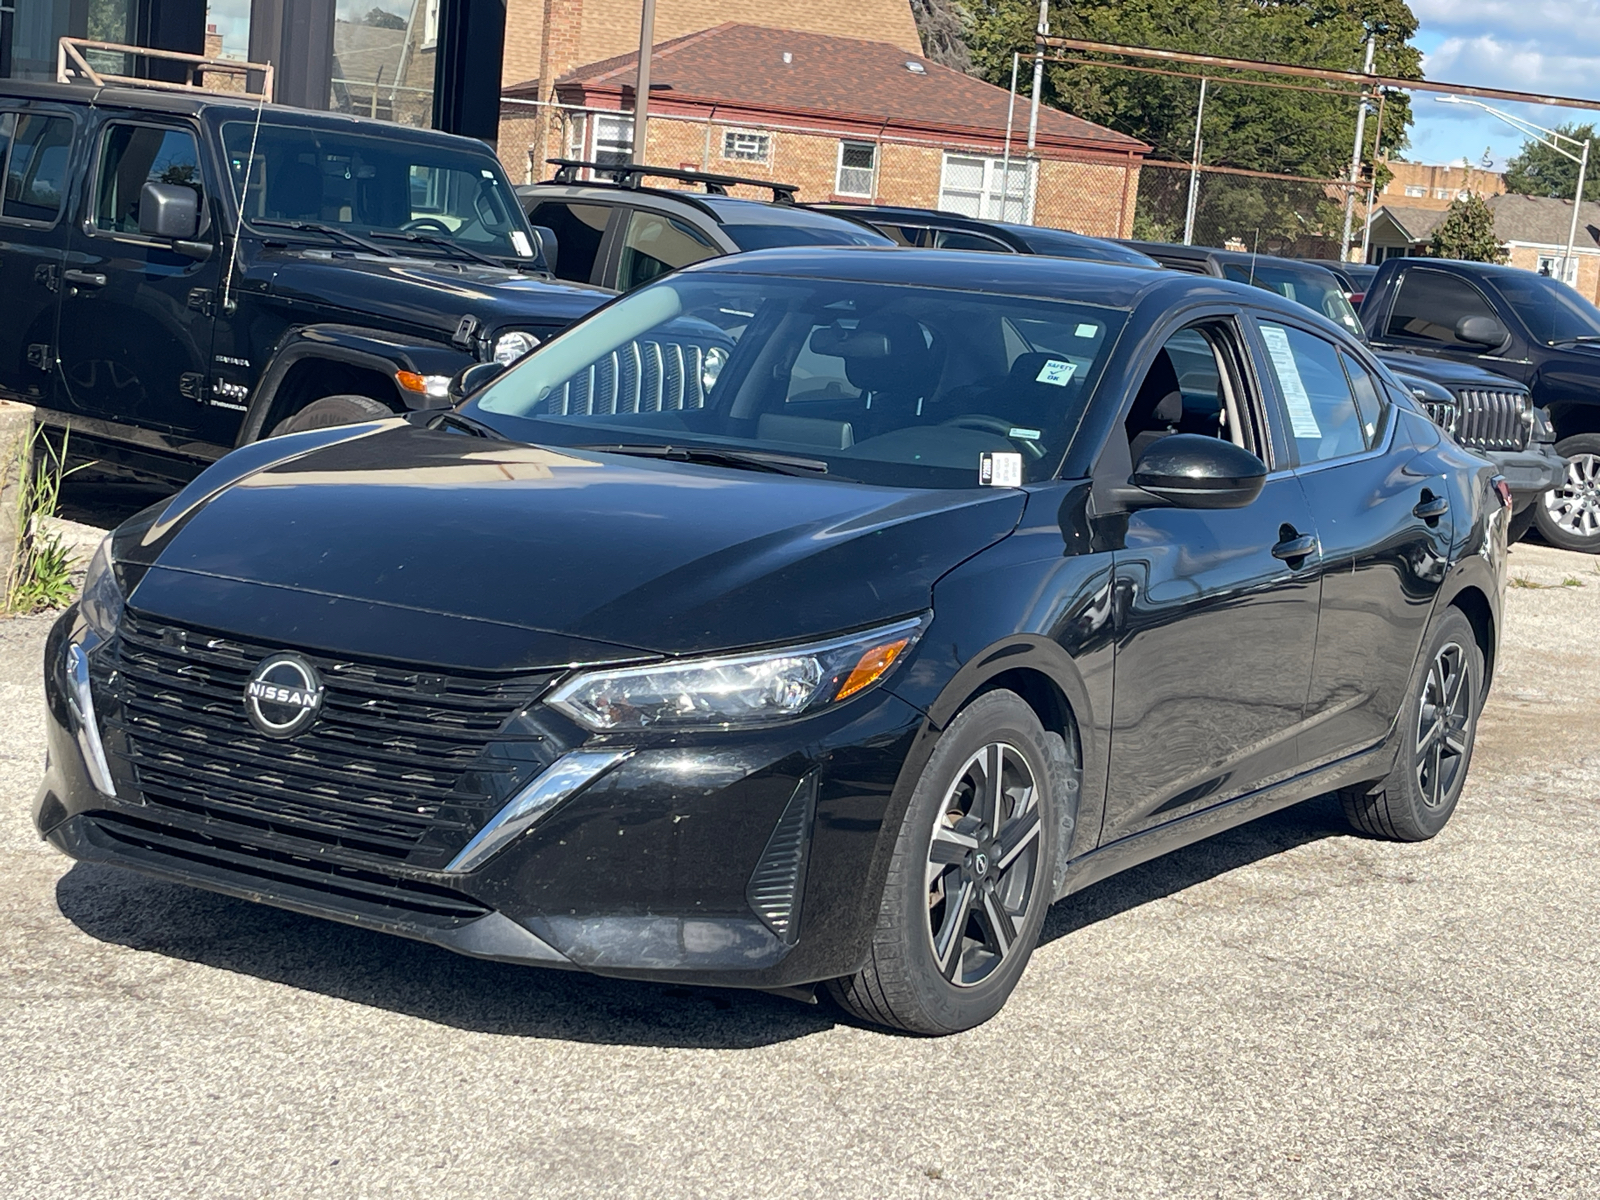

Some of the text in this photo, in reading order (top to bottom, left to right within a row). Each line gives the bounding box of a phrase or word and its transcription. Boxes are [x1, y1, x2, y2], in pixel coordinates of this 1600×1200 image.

[1047, 362, 1074, 371] SAFETY
[213, 377, 249, 402] Jeep
[249, 682, 317, 707] NISSAN
